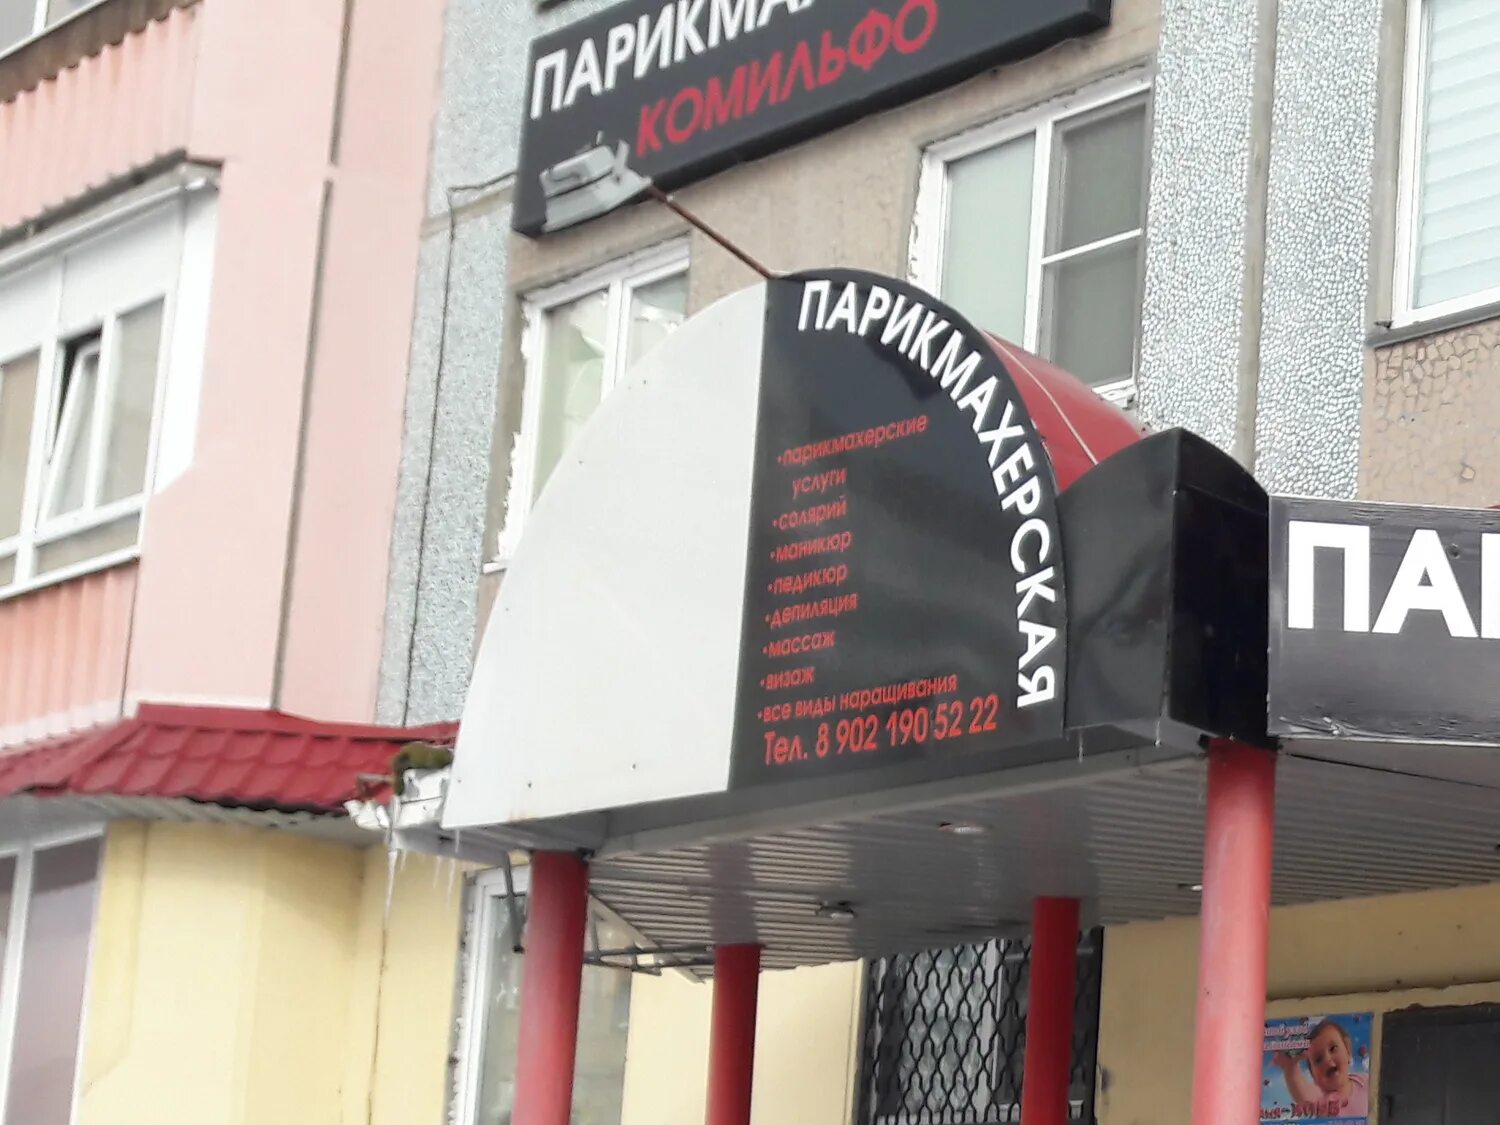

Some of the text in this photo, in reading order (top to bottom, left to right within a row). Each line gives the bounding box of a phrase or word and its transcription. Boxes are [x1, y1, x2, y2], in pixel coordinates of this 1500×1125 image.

[530, 0, 814, 119] ПАРИКМ
[636, 0, 938, 158] КОМИЛЬФО
[782, 414, 929, 467] парикмахерские
[792, 467, 848, 499] услуги
[798, 280, 1058, 709] ПАРИКМАХЕРСКАЯ
[778, 495, 849, 530] солярий
[775, 531, 852, 562] маникюр
[773, 564, 849, 594] педикюр
[770, 593, 859, 630] депиляция
[768, 629, 836, 658] массаж
[766, 666, 815, 690] визаж
[763, 673, 958, 723] все виды наращивания
[764, 693, 999, 765] Тел. 8 902 190 52 22
